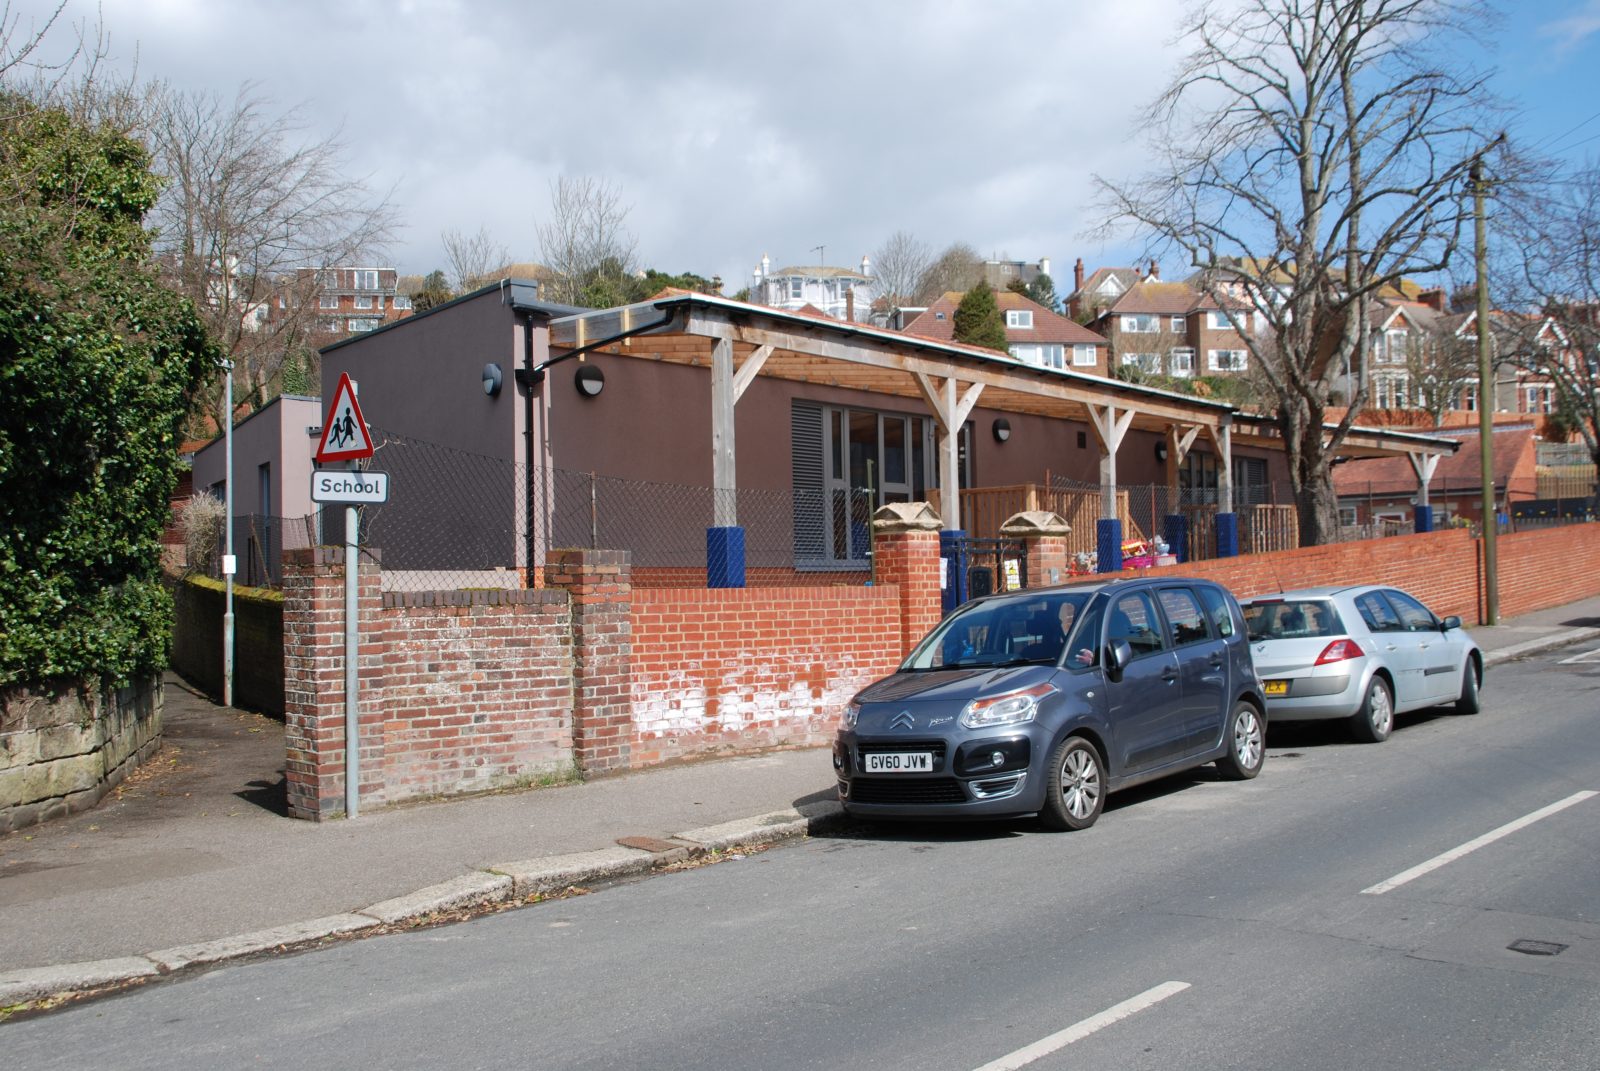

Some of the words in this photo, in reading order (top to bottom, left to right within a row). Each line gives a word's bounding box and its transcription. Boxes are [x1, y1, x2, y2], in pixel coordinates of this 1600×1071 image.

[320, 478, 380, 494] School
[871, 755, 900, 769] GV60
[904, 755, 926, 769] JVW
